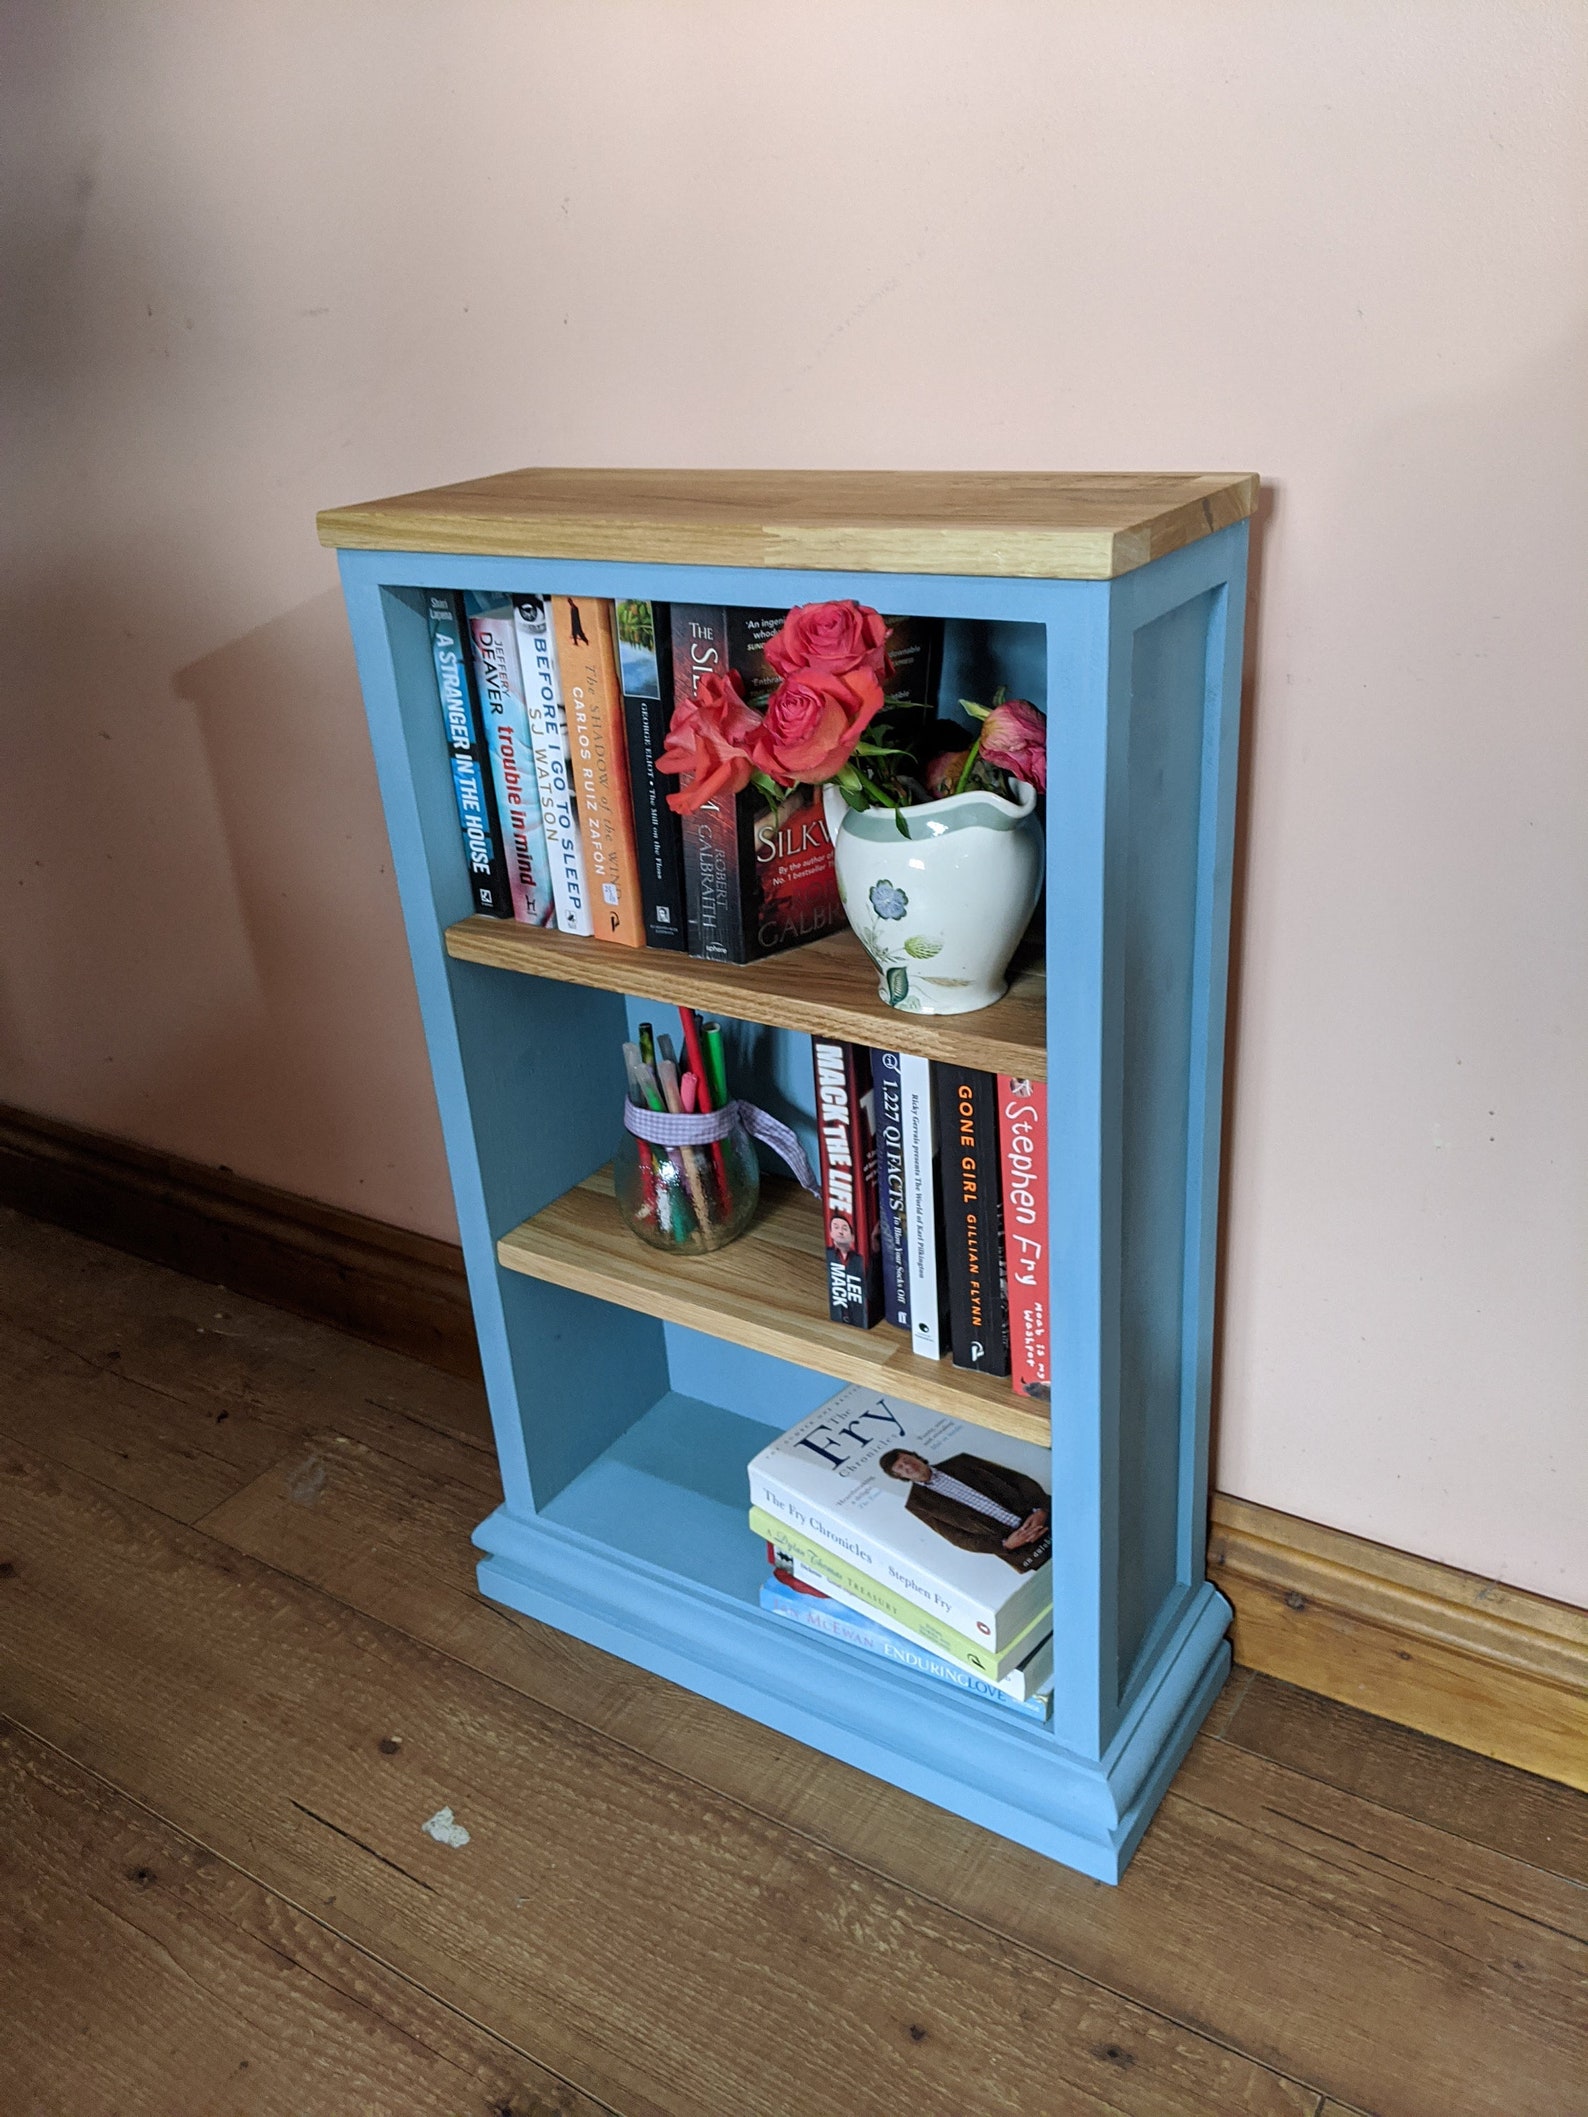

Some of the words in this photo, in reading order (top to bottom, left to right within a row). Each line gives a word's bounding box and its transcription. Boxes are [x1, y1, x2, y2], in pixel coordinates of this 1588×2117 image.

[435, 632, 454, 647] A
[688, 621, 714, 640] THE
[753, 628, 780, 640] whod
[761, 616, 786, 629] ingen
[480, 632, 504, 715] DEAVER
[494, 640, 511, 698] JEFFERY
[533, 637, 559, 735] BEFORE
[585, 664, 598, 695] The
[438, 650, 471, 750] STRANGER
[572, 686, 591, 761] CARLOS
[641, 702, 652, 746] GEORGE
[455, 753, 474, 774] IN
[497, 725, 523, 806] trouble
[548, 743, 561, 751] I
[590, 704, 609, 790] SHADOW
[645, 748, 655, 778] ELIOT
[460, 776, 480, 812] THE
[534, 747, 559, 842] WATSON
[551, 760, 566, 791] GO
[582, 767, 598, 812] RUIZ
[510, 809, 526, 831] in
[556, 801, 571, 829] TO
[603, 818, 616, 842] the
[650, 807, 659, 825] Mill
[653, 827, 658, 838] on
[465, 815, 491, 876] HOUSE
[514, 832, 537, 887] mind
[588, 819, 606, 876] ZAFÓN
[778, 866, 788, 875] By
[789, 862, 801, 871] the
[802, 855, 825, 867] author
[562, 838, 582, 910] SLEEP
[698, 824, 717, 928] GALBRAITH
[714, 848, 729, 911] ROBERT
[793, 864, 826, 880] bestseller
[816, 1044, 849, 1125] MACK
[882, 1080, 900, 1123] 1,227
[911, 1094, 919, 1115] Ricky
[912, 1116, 920, 1144] Gervais
[958, 1084, 975, 1147] GONE
[823, 1124, 852, 1167] THE
[883, 1126, 900, 1149] QI
[887, 1151, 904, 1212] FACTS
[912, 1145, 920, 1176] presents
[961, 1156, 978, 1204] GIRL
[1005, 1101, 1038, 1225] Stephen
[828, 1168, 852, 1214] LIFE
[893, 1216, 901, 1227] To
[894, 1226, 902, 1244] Blow
[917, 1215, 923, 1224] of
[895, 1246, 903, 1266] Your
[917, 1242, 925, 1278] Pilkington
[966, 1214, 980, 1275] GILLIAN
[1012, 1233, 1042, 1286] Fry
[830, 1262, 848, 1309] MACK
[846, 1268, 862, 1305] LEE
[896, 1266, 905, 1288] Socks
[897, 1289, 906, 1304] Off
[970, 1280, 984, 1326] FLYNN
[793, 1399, 905, 1471] Fry
[828, 1408, 852, 1424] The
[838, 1433, 898, 1478] Chronicles
[763, 1488, 785, 1510] The
[788, 1503, 806, 1525] Fry
[809, 1517, 872, 1564] Chronicles
[888, 1566, 931, 1599] Stephen
[934, 1594, 952, 1613] Fry
[847, 1578, 898, 1614] TREASURY
[884, 1643, 968, 1686] ENDURING
[968, 1676, 1007, 1702] LOVE
